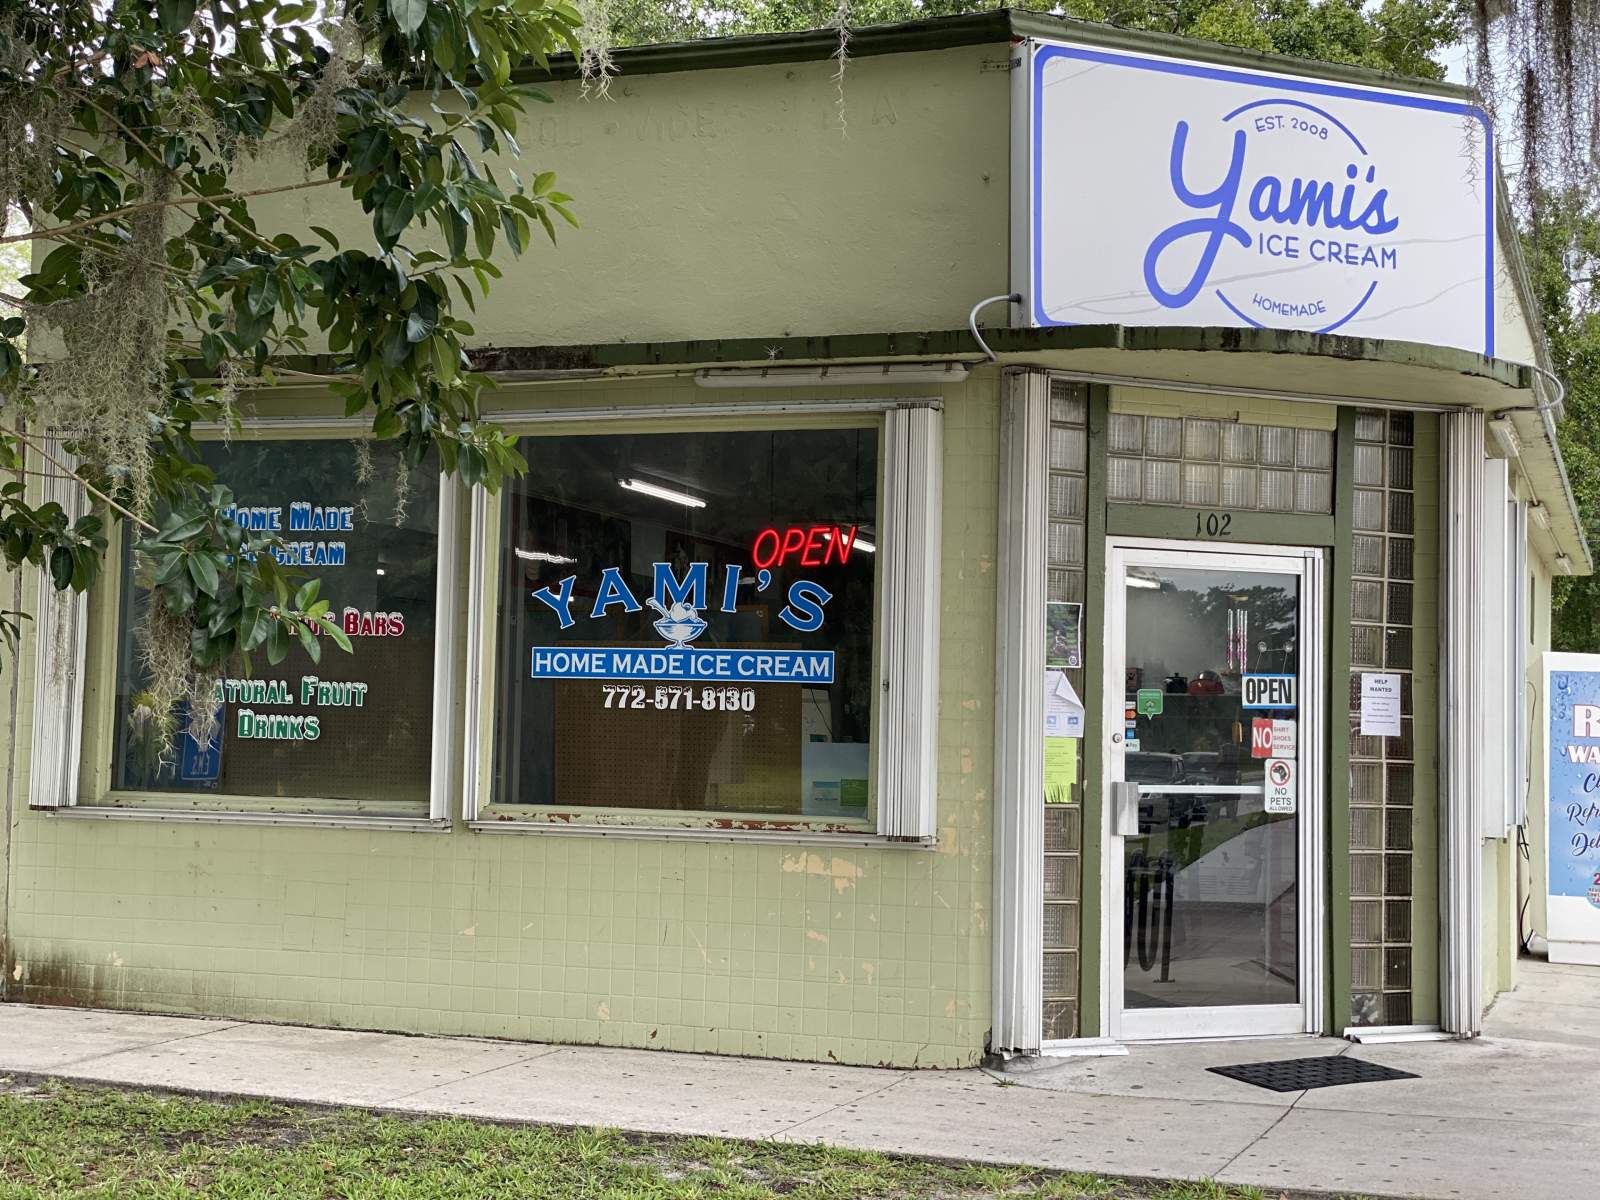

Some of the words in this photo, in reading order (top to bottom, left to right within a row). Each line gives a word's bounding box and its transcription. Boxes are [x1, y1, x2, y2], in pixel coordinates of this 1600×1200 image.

[1254, 115, 1285, 132] EST.
[1291, 117, 1329, 140] 2008
[1143, 120, 1399, 309] Yami's
[1259, 232, 1300, 258] ICE
[1309, 239, 1398, 270] CREAM
[1252, 293, 1327, 317] HOMEMADE
[289, 501, 354, 531] MADE
[1195, 512, 1232, 537] 102
[753, 525, 858, 569] OPEN
[531, 562, 833, 632] YAMI'S
[343, 605, 405, 637] BARS
[535, 652, 606, 674] HOME
[612, 653, 684, 675] MADE
[690, 654, 731, 676] ICE
[737, 655, 830, 679] CREAM
[211, 678, 293, 704] ATURAL
[301, 675, 368, 707] FRUIT
[602, 685, 756, 712] 772-571-8130
[1246, 678, 1292, 705] OPEN
[237, 708, 320, 740] DRINKS
[1252, 726, 1273, 749] NO
[1273, 726, 1289, 734] SHIRT
[1272, 743, 1296, 751] SERVICE
[1270, 797, 1292, 807] PETS
[1274, 787, 1288, 796] NO
